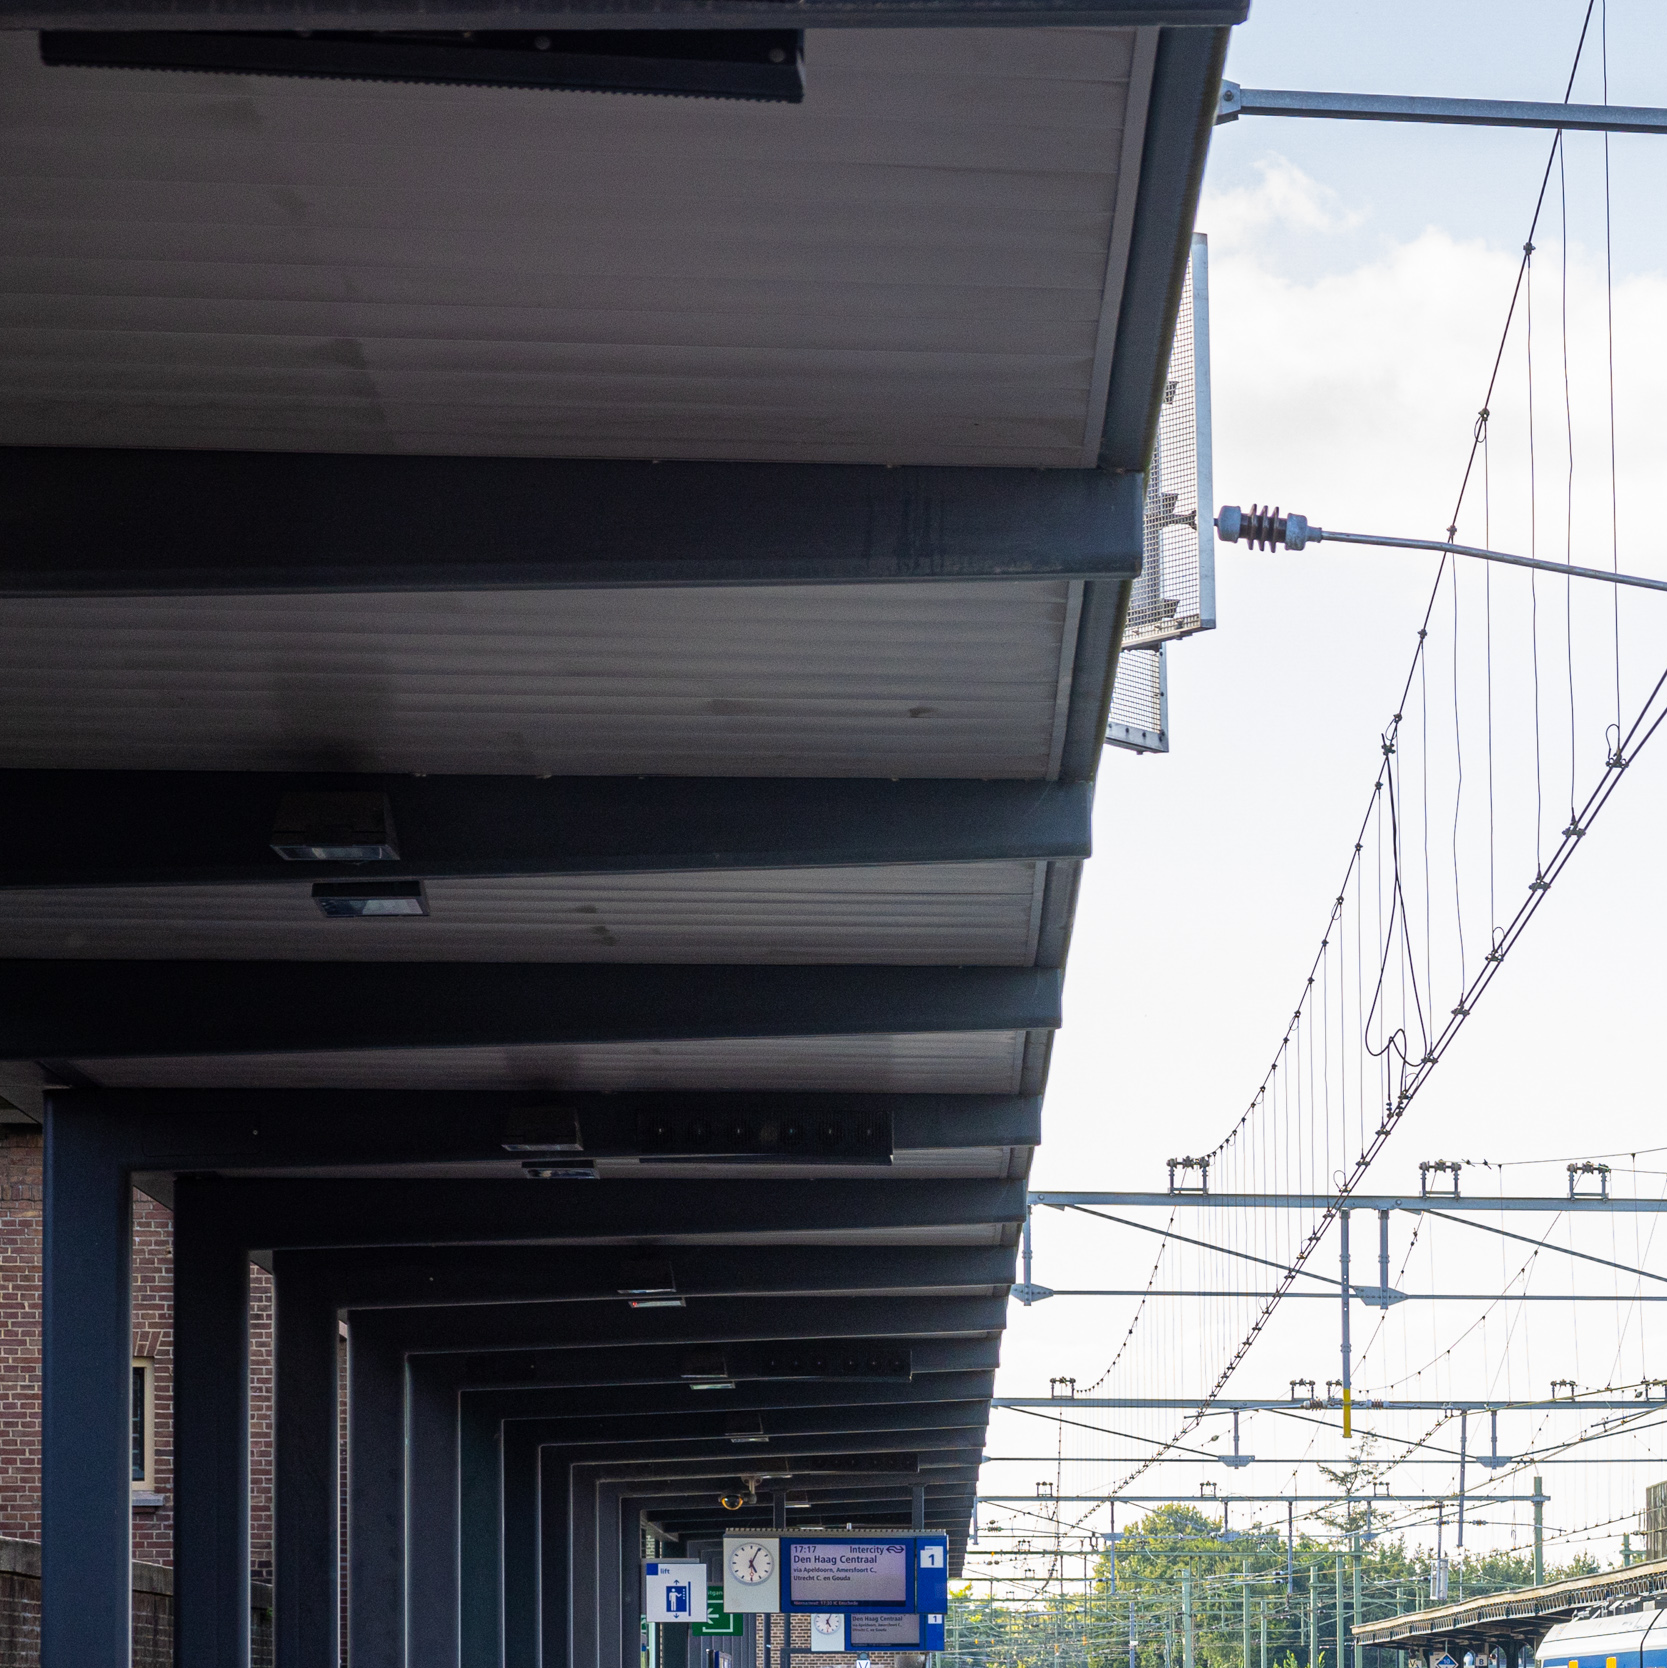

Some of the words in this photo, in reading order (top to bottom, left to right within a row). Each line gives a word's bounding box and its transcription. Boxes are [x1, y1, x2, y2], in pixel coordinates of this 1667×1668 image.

[793, 1545, 817, 1554] 17:17
[850, 1545, 885, 1555] Intercity
[793, 1555, 811, 1564] Den
[814, 1555, 837, 1566] Haag
[840, 1555, 877, 1564] Centraal
[928, 1553, 935, 1566] 1
[803, 1567, 834, 1575] Apeldoorn,
